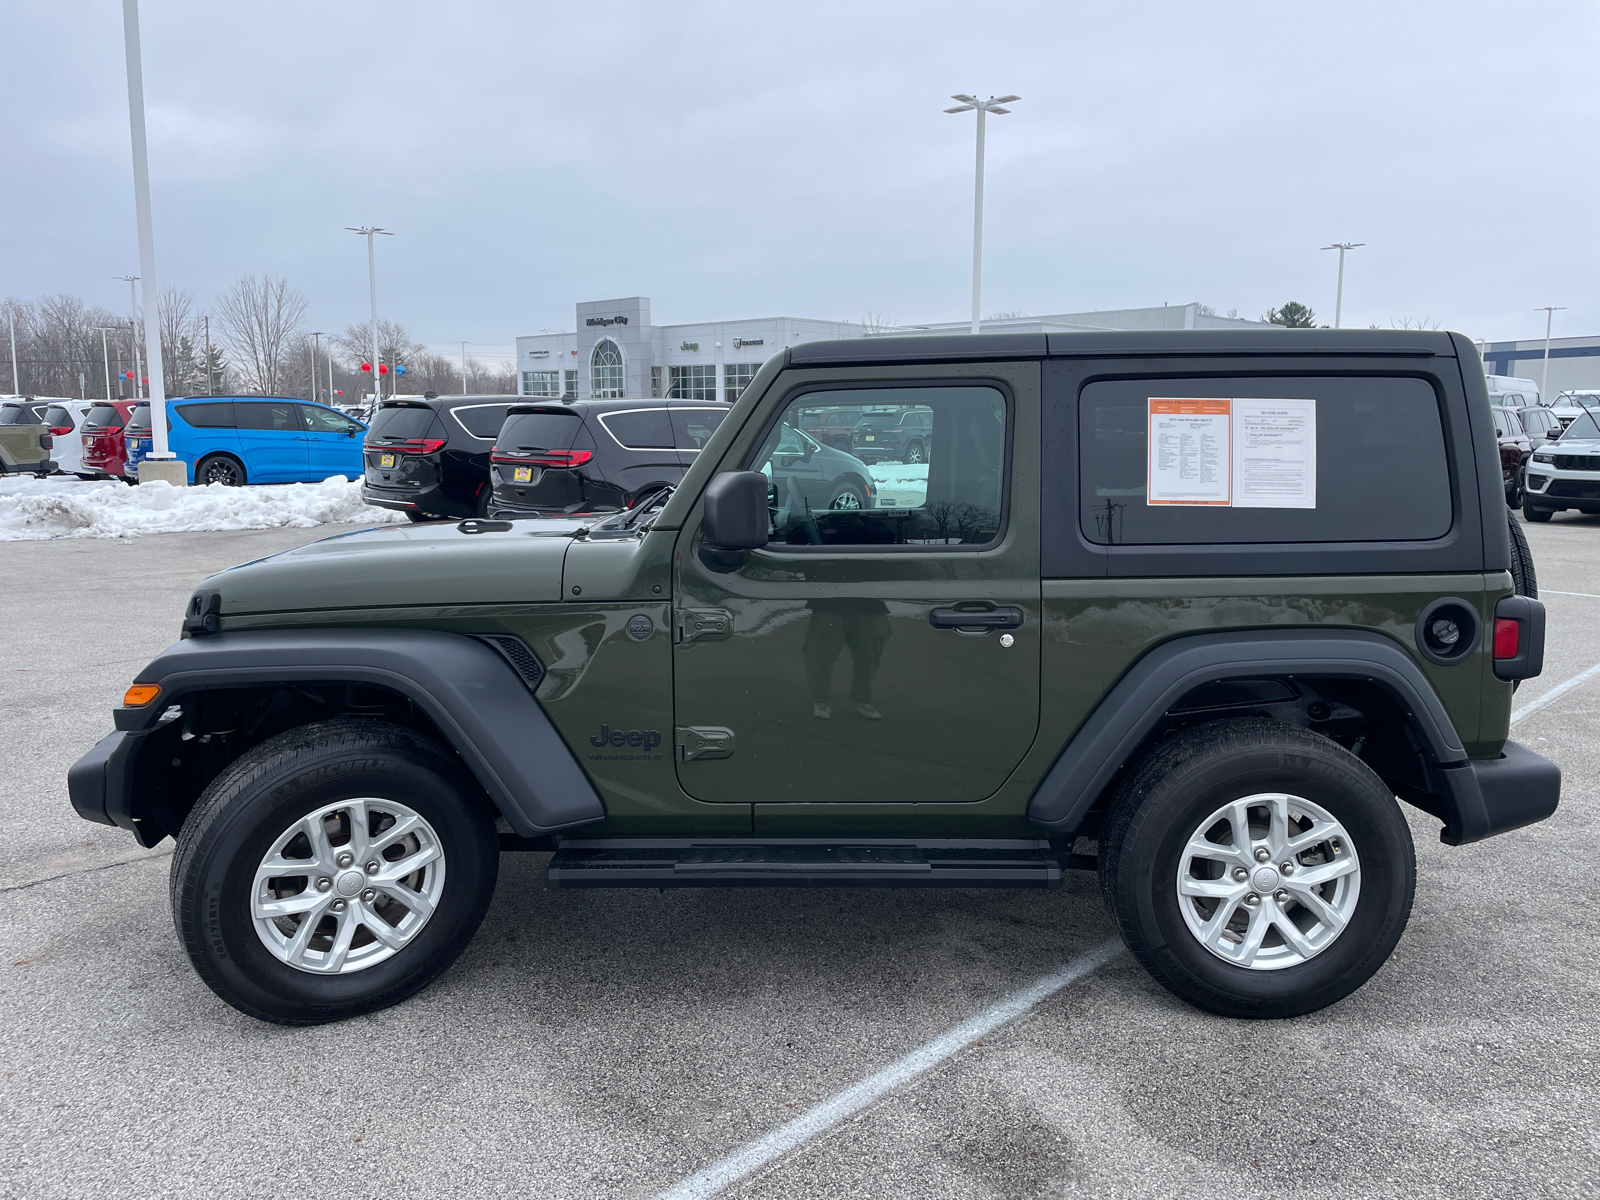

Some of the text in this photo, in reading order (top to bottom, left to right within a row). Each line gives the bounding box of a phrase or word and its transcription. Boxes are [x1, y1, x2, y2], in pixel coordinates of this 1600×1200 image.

[586, 316, 628, 327] Michigan City
[680, 341, 699, 352] Jeep
[590, 723, 661, 751] Jeep
[342, 877, 359, 891] Jeep
